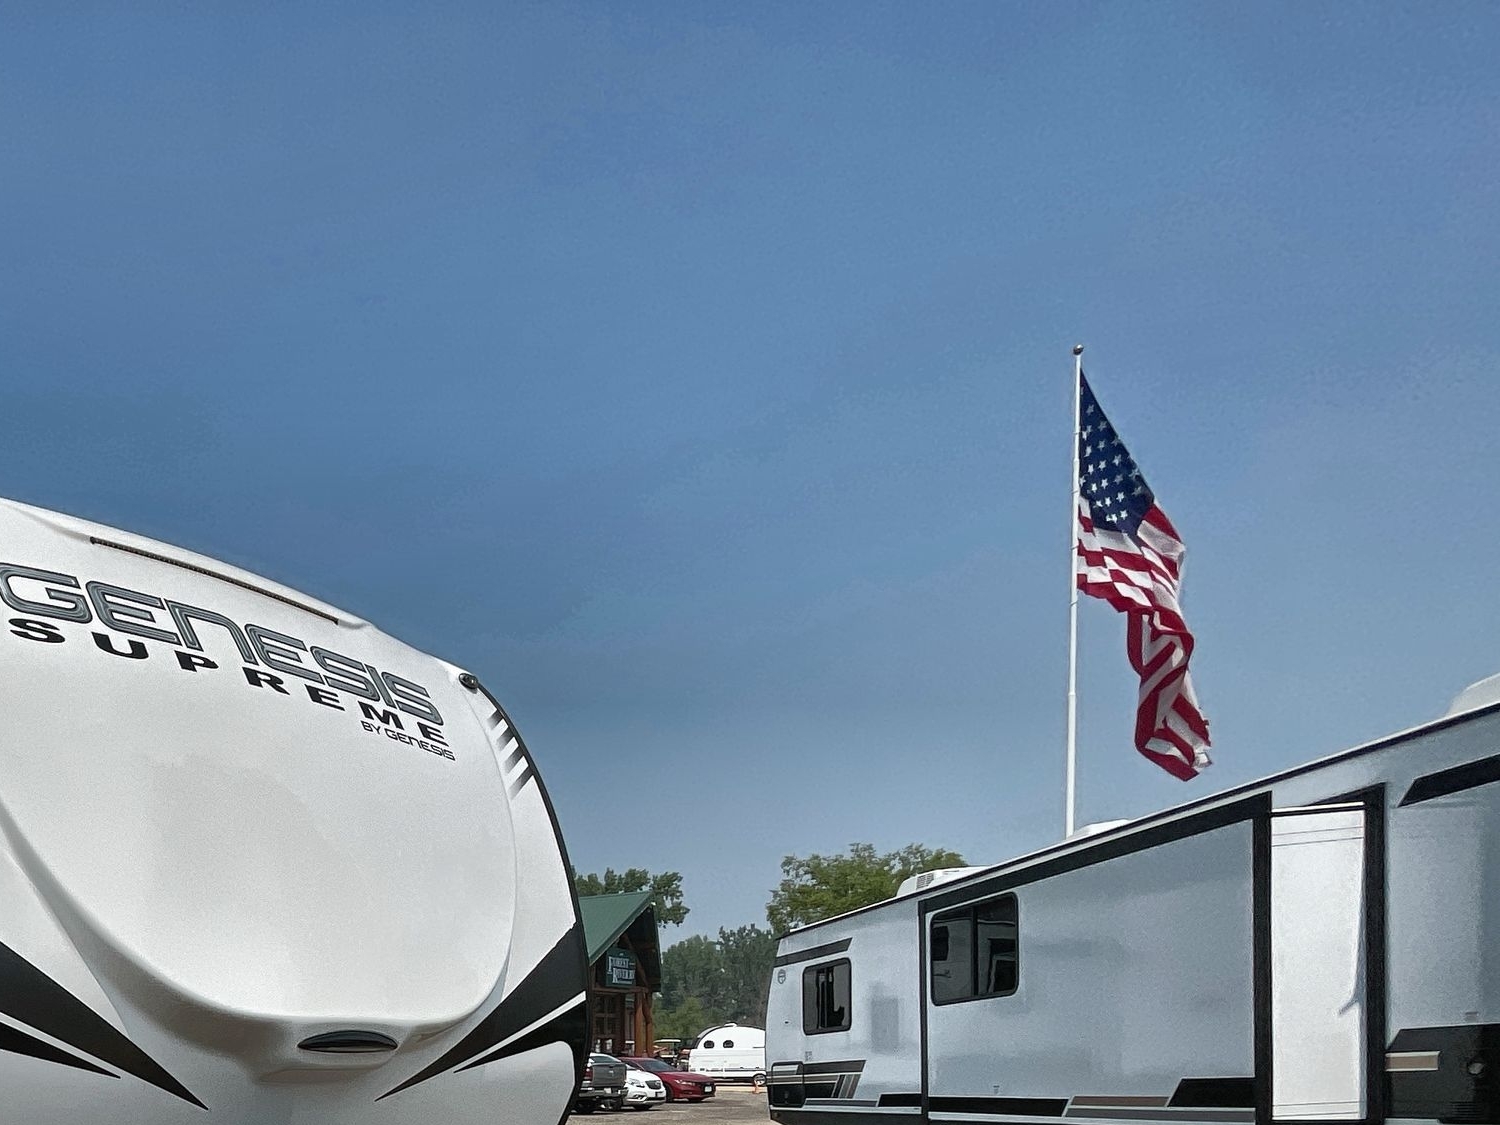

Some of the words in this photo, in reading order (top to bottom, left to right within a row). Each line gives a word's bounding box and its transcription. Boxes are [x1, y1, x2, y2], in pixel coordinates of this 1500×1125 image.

[8, 618, 449, 747] SUPREME
[361, 720, 381, 735] BY
[384, 728, 456, 761] GENESIS
